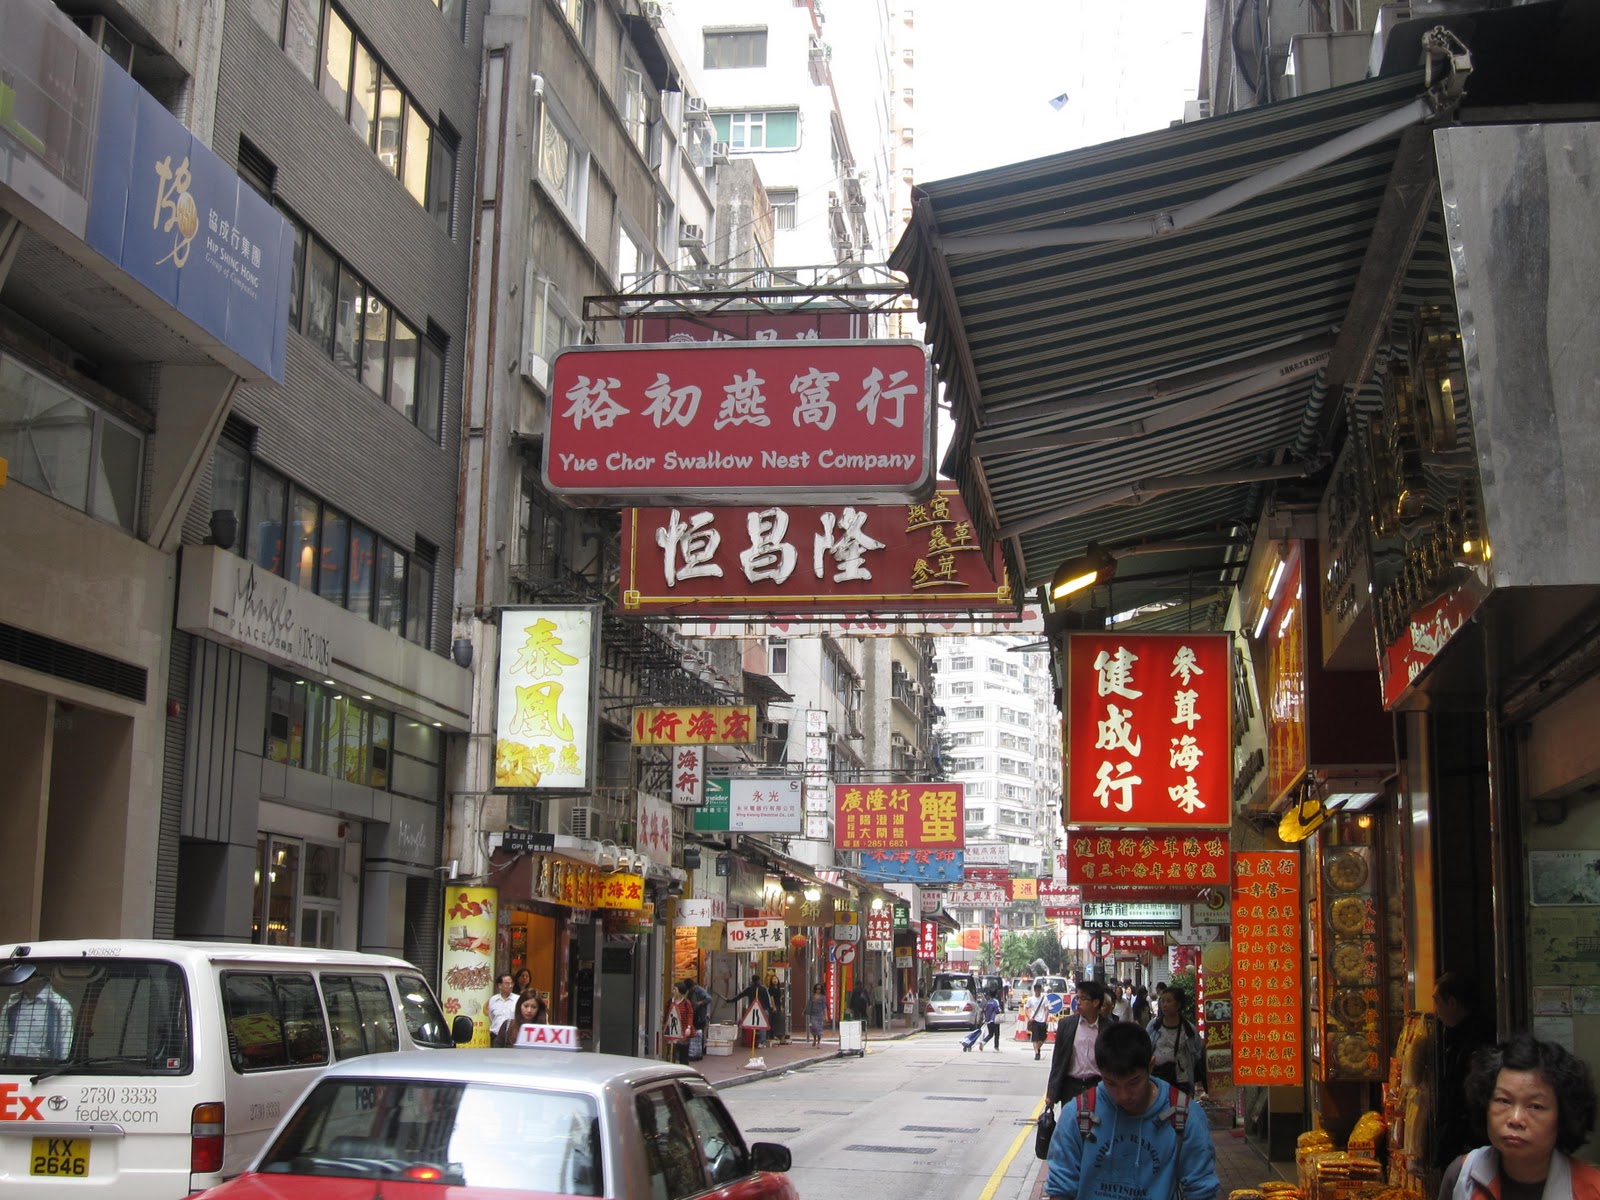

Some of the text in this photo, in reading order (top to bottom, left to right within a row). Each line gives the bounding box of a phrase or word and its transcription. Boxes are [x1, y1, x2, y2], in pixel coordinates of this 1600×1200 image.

[208, 208, 261, 268] 協成行集團
[240, 264, 259, 288] HONG
[561, 366, 918, 431] 裕初燕窩行
[559, 449, 915, 471] Yue Chor Swallow Nest Company
[656, 506, 886, 587] 恒昌隆
[1093, 646, 1143, 812] 健成行
[1167, 645, 1207, 814] 參茸海味
[753, 790, 779, 802] 永光
[841, 788, 911, 812] 廣隆行
[919, 791, 957, 842] 蟹
[1073, 837, 1224, 858] 健成行參茸海味
[1234, 858, 1295, 878] 健成行
[1084, 920, 1103, 928] Eric
[524, 1027, 571, 1044] TAXI
[80, 1087, 157, 1104] 2730 3333
[76, 1105, 158, 1122] fedex.com
[48, 1139, 73, 1156] KX
[34, 1157, 86, 1175] 2646
